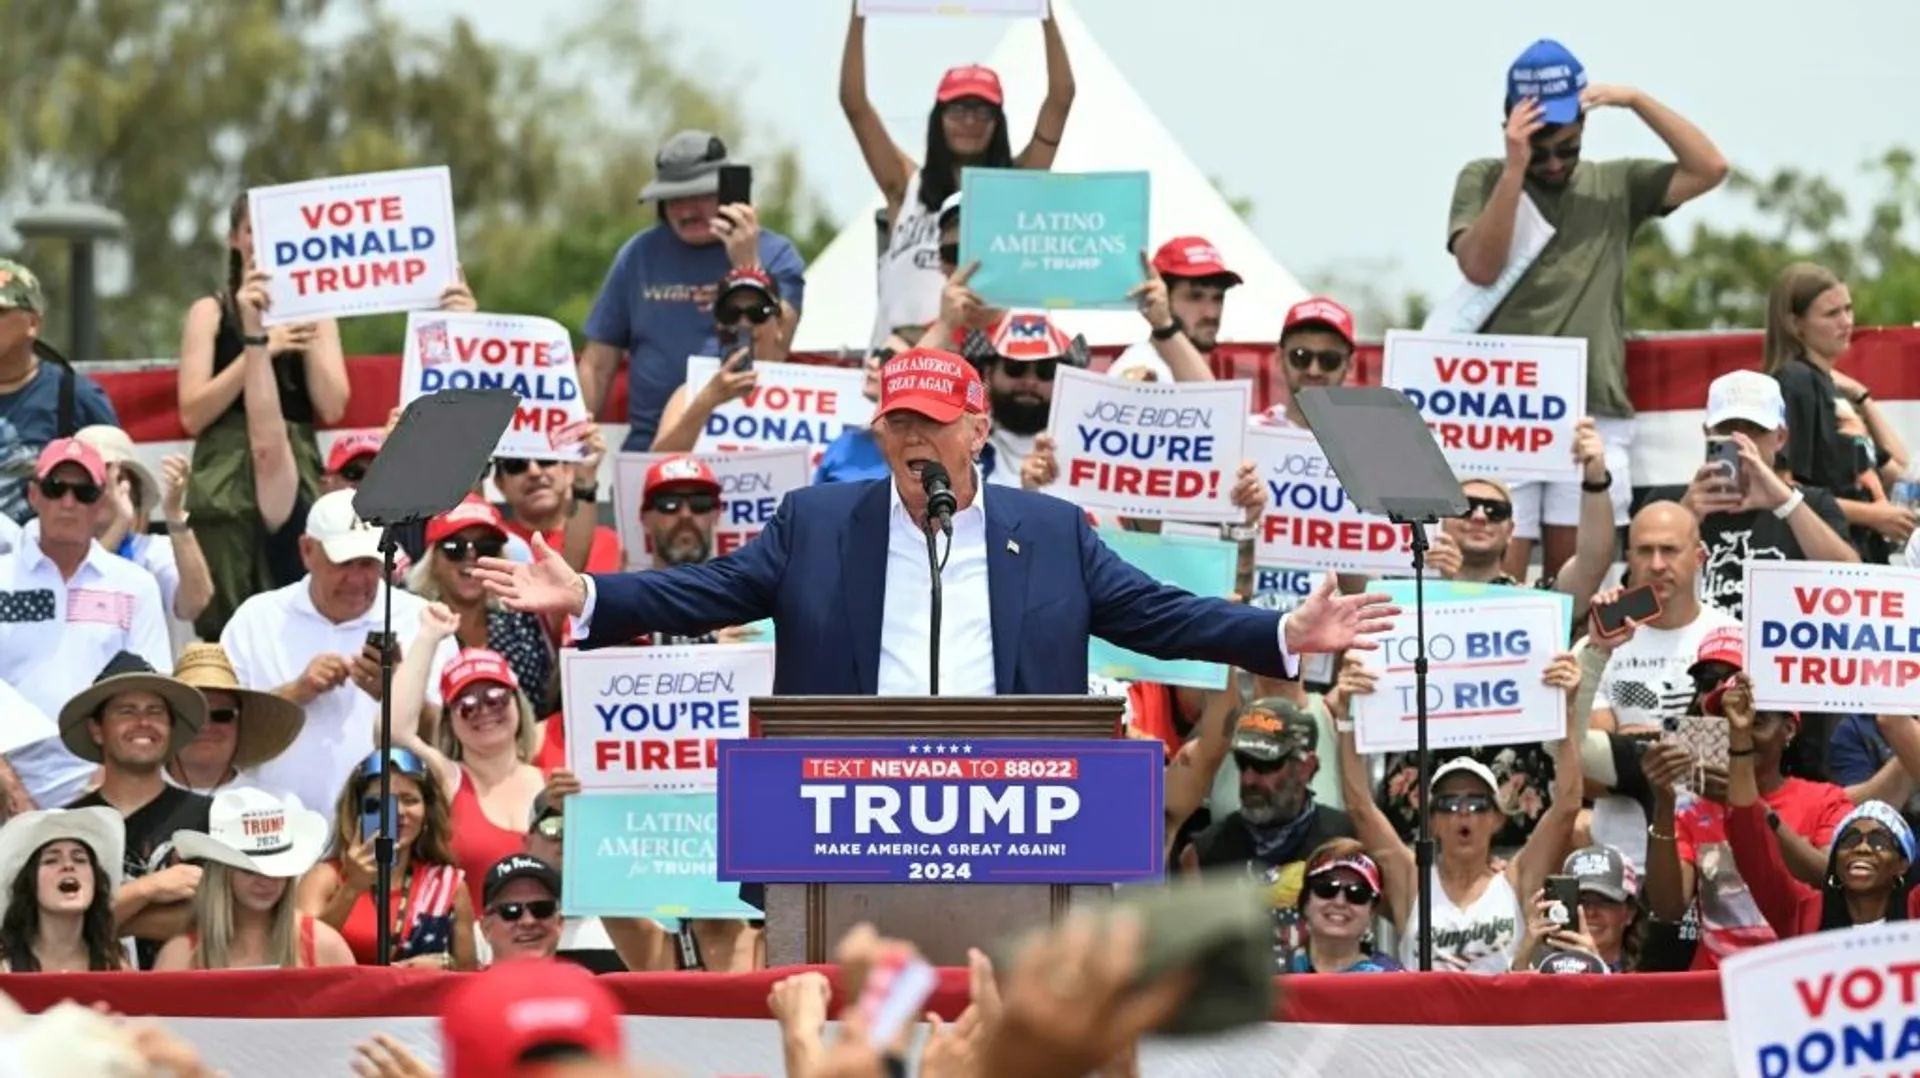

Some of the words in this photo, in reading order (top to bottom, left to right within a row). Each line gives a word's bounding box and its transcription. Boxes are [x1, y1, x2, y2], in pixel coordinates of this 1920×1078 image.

[300, 195, 404, 229] VOTE
[1017, 211, 1106, 232] LATINO
[274, 226, 436, 267] DONALD
[989, 233, 1127, 255] AMERICANS
[289, 259, 427, 297] TRUMP
[1042, 257, 1102, 271] TRUMP
[454, 336, 552, 368] VOTE
[420, 368, 577, 401] DONALD
[1433, 356, 1538, 388] VOTE
[740, 385, 839, 415] VOTE
[1083, 399, 1133, 425] JOE
[1137, 404, 1213, 430] BIDEN,
[706, 414, 859, 445] DONAL
[1077, 424, 1215, 463] YOU'RE
[1069, 459, 1221, 499] FIRED!
[1272, 454, 1323, 478] JOE
[1262, 515, 1413, 553] FIRED!
[1259, 569, 1311, 596] BIG
[1794, 586, 1905, 618] VOTE
[1379, 634, 1455, 666] TOO
[1465, 629, 1532, 660] BIG
[600, 674, 651, 697] JOE
[655, 671, 735, 696] BIDEN,
[1774, 656, 1920, 688] TRUMP
[1396, 684, 1443, 713] TO
[1454, 679, 1520, 710] RIG
[594, 700, 741, 733] YOU'RE
[594, 738, 718, 772] FIRE
[809, 760, 865, 777] TEXT
[871, 760, 962, 777] NEVADA
[969, 760, 998, 777] TO
[1004, 760, 1072, 778] 88022
[800, 784, 1081, 835] TRUMP
[596, 837, 717, 858] AMERICA
[814, 843, 862, 856] MAKE
[867, 843, 942, 856] AMERICA
[947, 843, 1002, 856] GREAT
[1007, 843, 1067, 856] AGAIN!
[908, 862, 972, 880] 2024
[1795, 960, 1920, 1020] VOT
[1758, 1014, 1920, 1078] DONA
